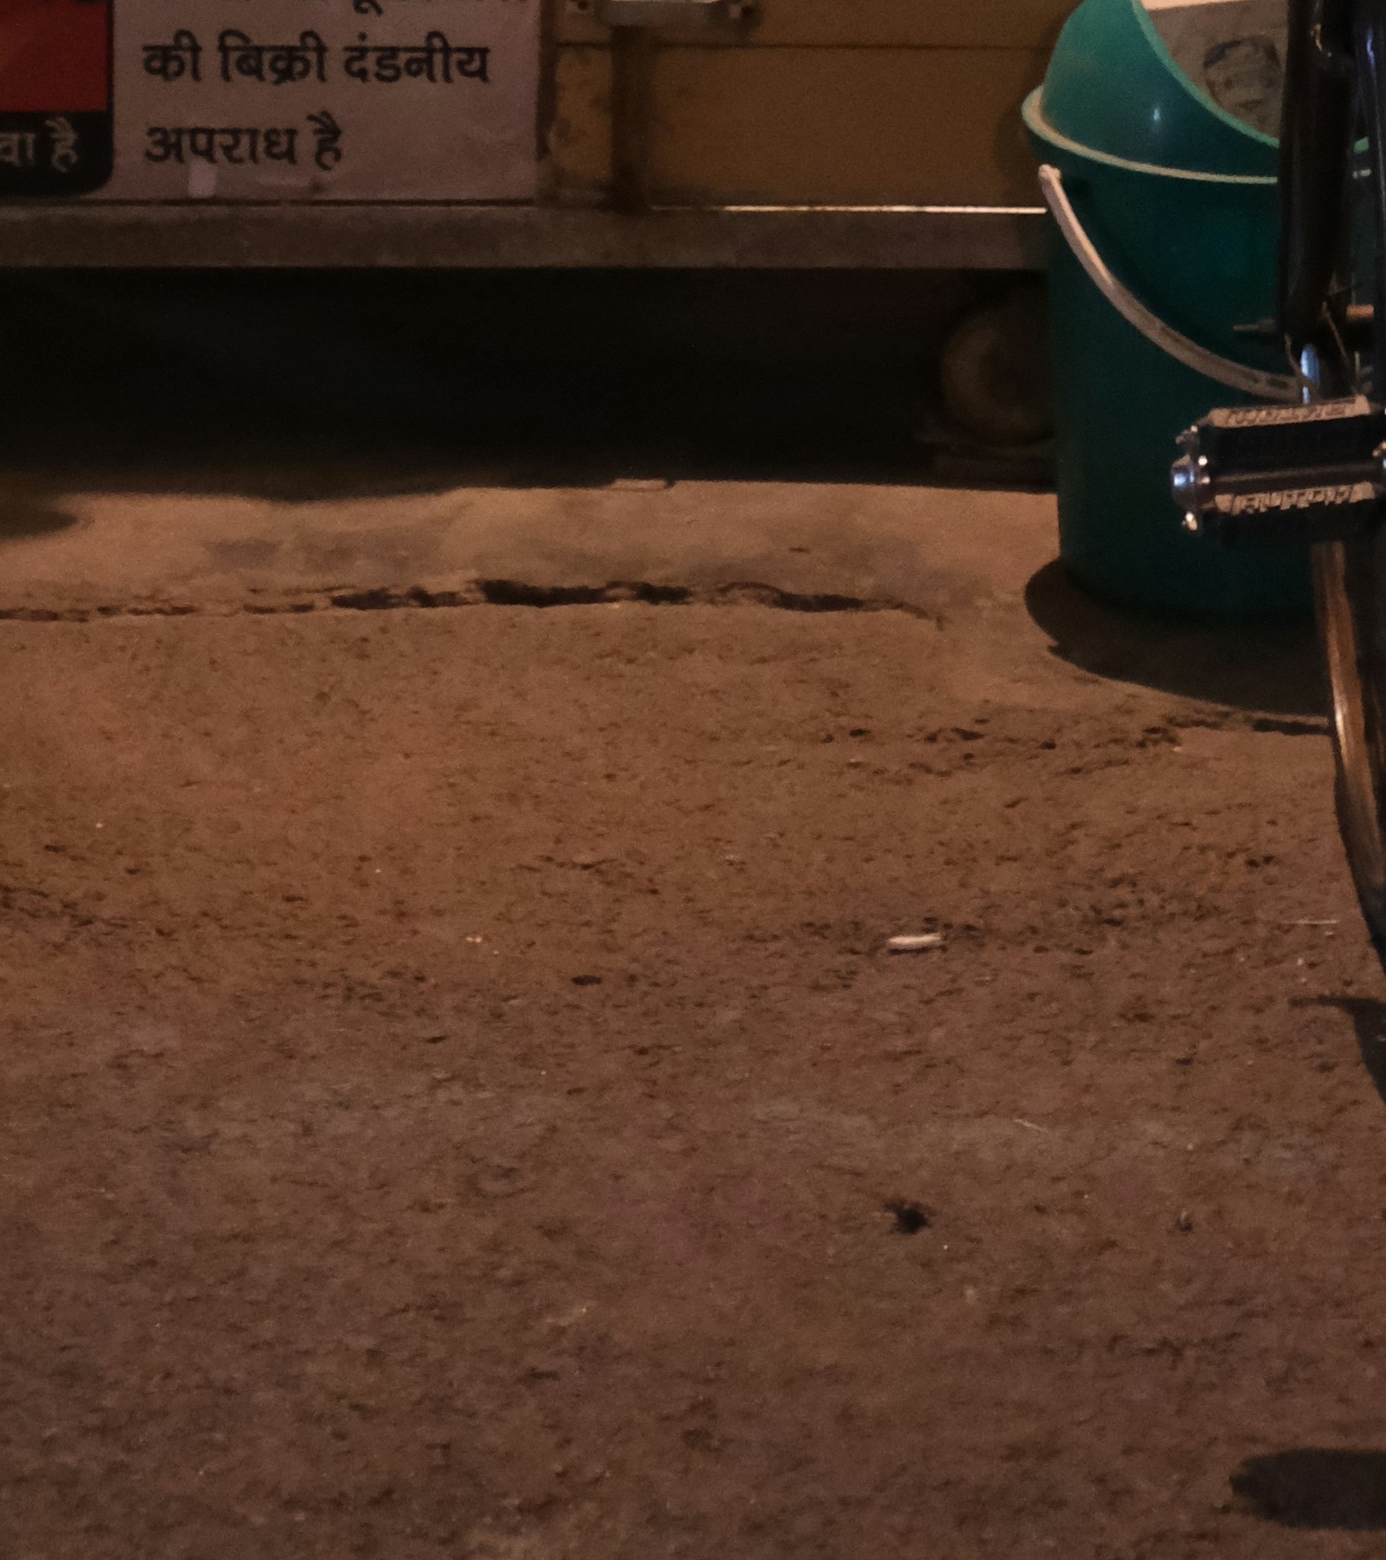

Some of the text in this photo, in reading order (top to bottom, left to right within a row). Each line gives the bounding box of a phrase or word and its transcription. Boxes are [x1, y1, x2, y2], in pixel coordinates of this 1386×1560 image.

[144, 31, 491, 85] की बिक्री दंडनीय
[47, 117, 80, 169] है
[144, 111, 343, 168] अपराध है
